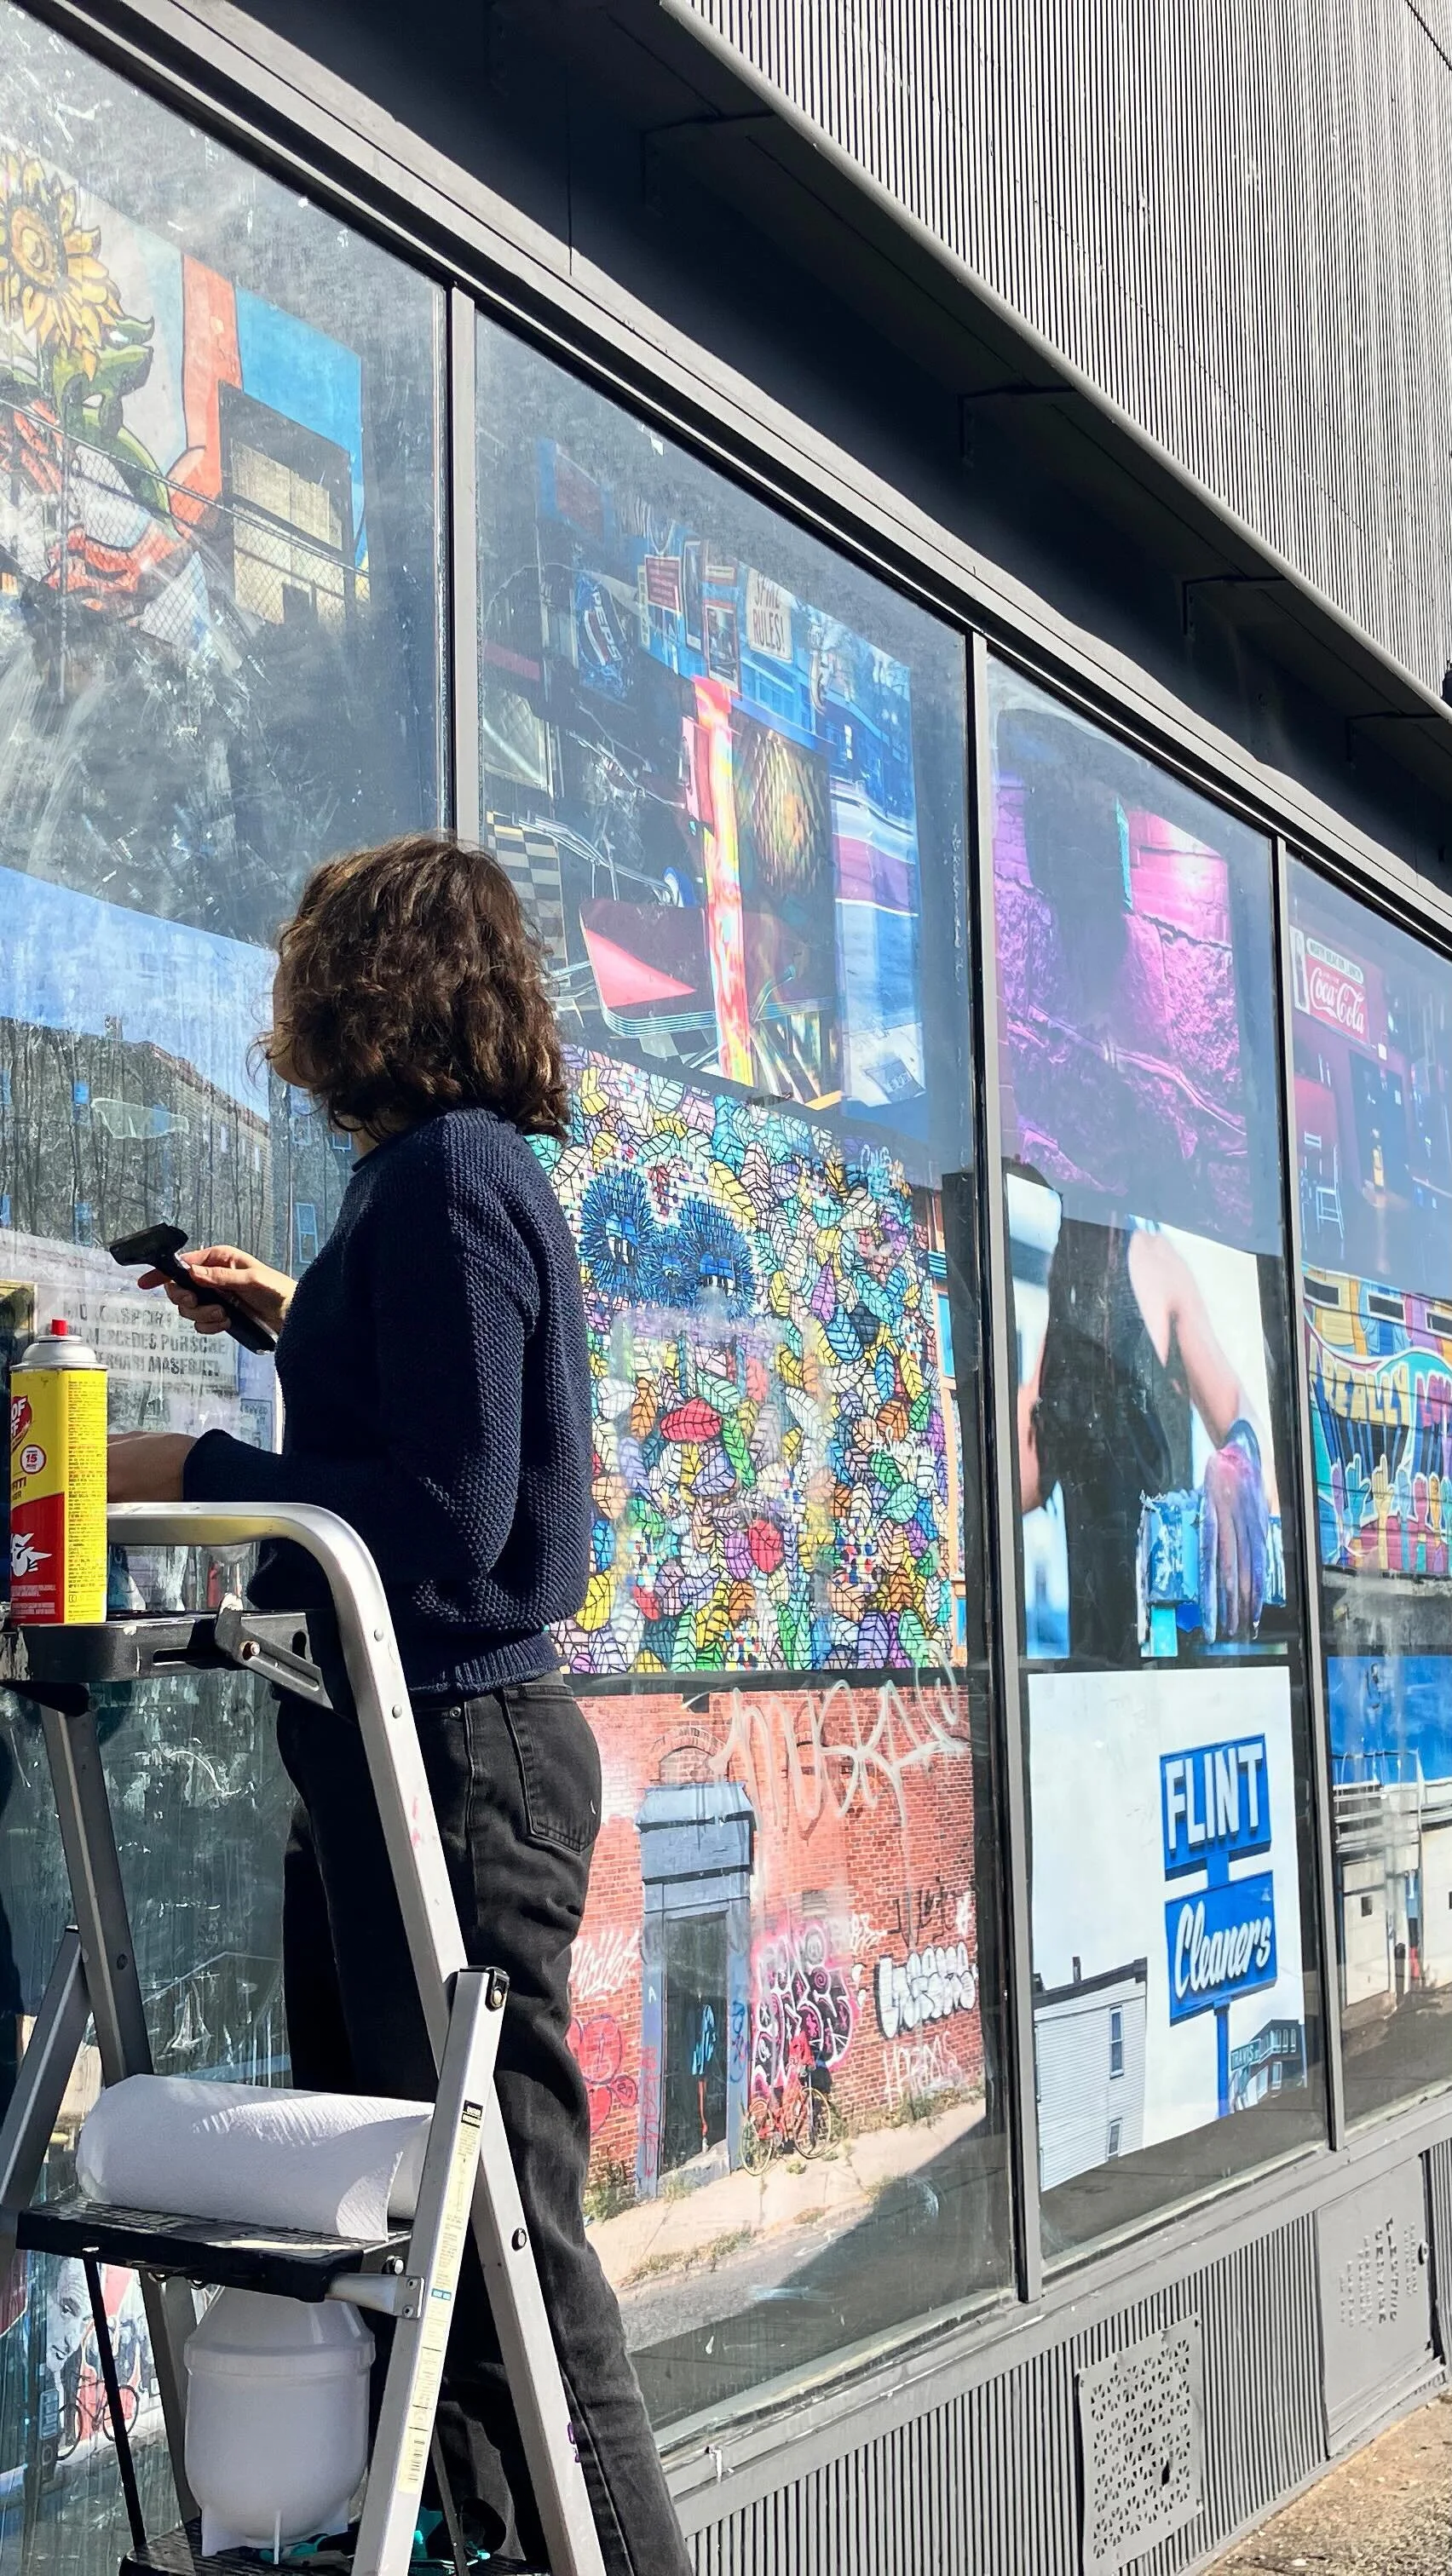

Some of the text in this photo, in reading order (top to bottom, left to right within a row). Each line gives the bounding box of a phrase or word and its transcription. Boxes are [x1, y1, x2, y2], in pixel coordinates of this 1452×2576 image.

[752, 608, 786, 653] RULES!
[1310, 967, 1365, 1033] Coca-Cola
[11, 1398, 27, 1421] OF
[26, 1453, 37, 1463] 15
[1165, 1744, 1264, 1851] FLINT
[1175, 1901, 1273, 2000] Cleaners
